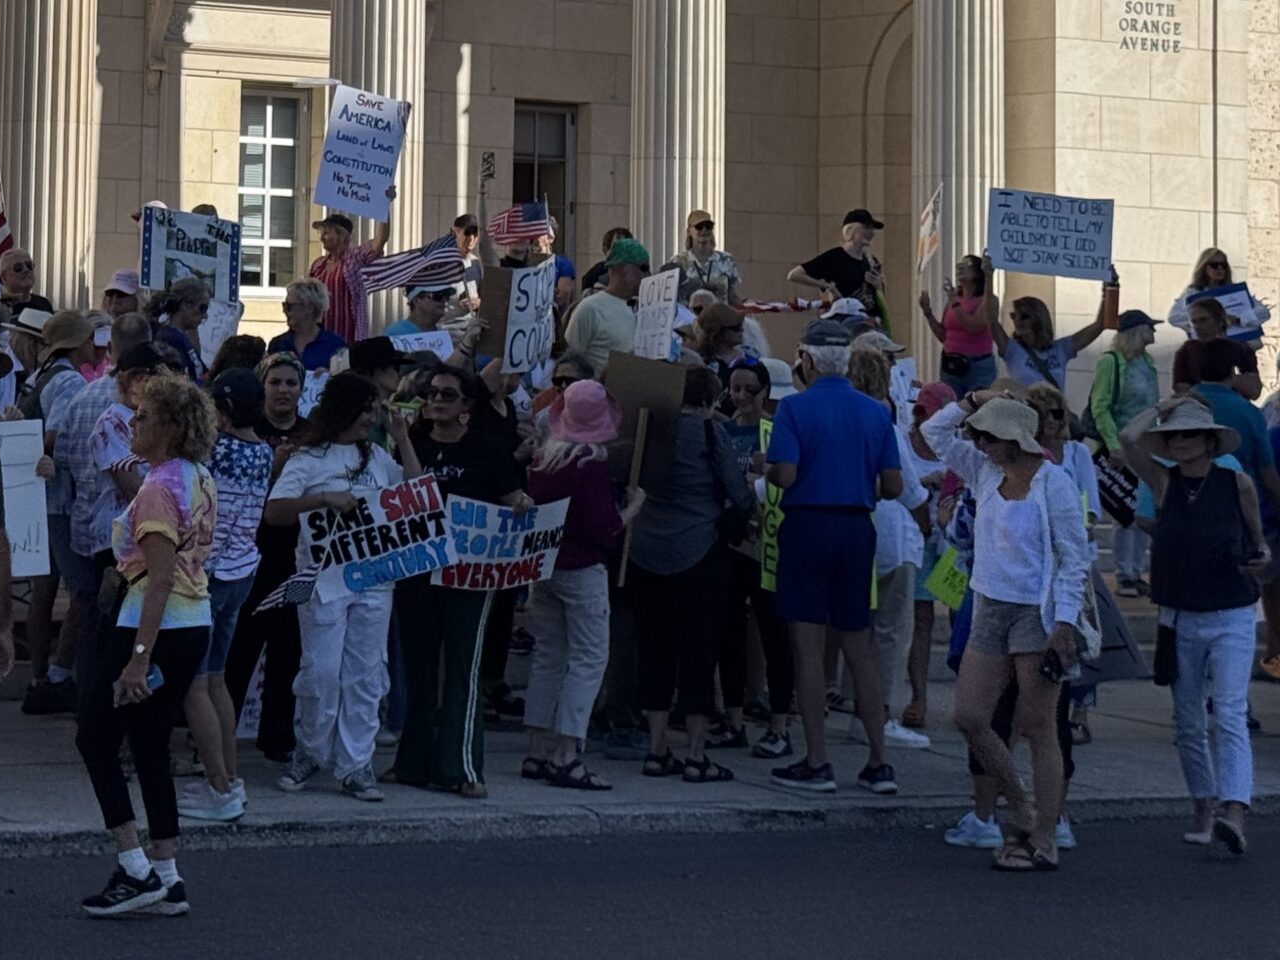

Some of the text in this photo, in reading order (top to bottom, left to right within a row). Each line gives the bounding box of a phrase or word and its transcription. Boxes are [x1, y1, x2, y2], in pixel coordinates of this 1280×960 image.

[1125, 1, 1176, 17] SOUTH
[1118, 18, 1182, 36] ORANGE
[1120, 36, 1182, 53] AVENUE
[338, 104, 391, 133] AMERICA
[323, 150, 394, 178] CONSTITUTION
[998, 192, 1107, 216] I NEED TO BE
[1001, 212, 1103, 234] ABLE TO TELL MY
[1000, 229, 1058, 247] CHILDREN
[1061, 235, 1071, 250] I
[1003, 246, 1028, 263] NOT
[1032, 250, 1059, 265] STAY
[308, 497, 375, 542] SAME
[451, 501, 539, 533] WE THE
[309, 510, 446, 572] DIFFERENT
[343, 537, 449, 593] CENTURY
[441, 553, 546, 588] EVERYONE
